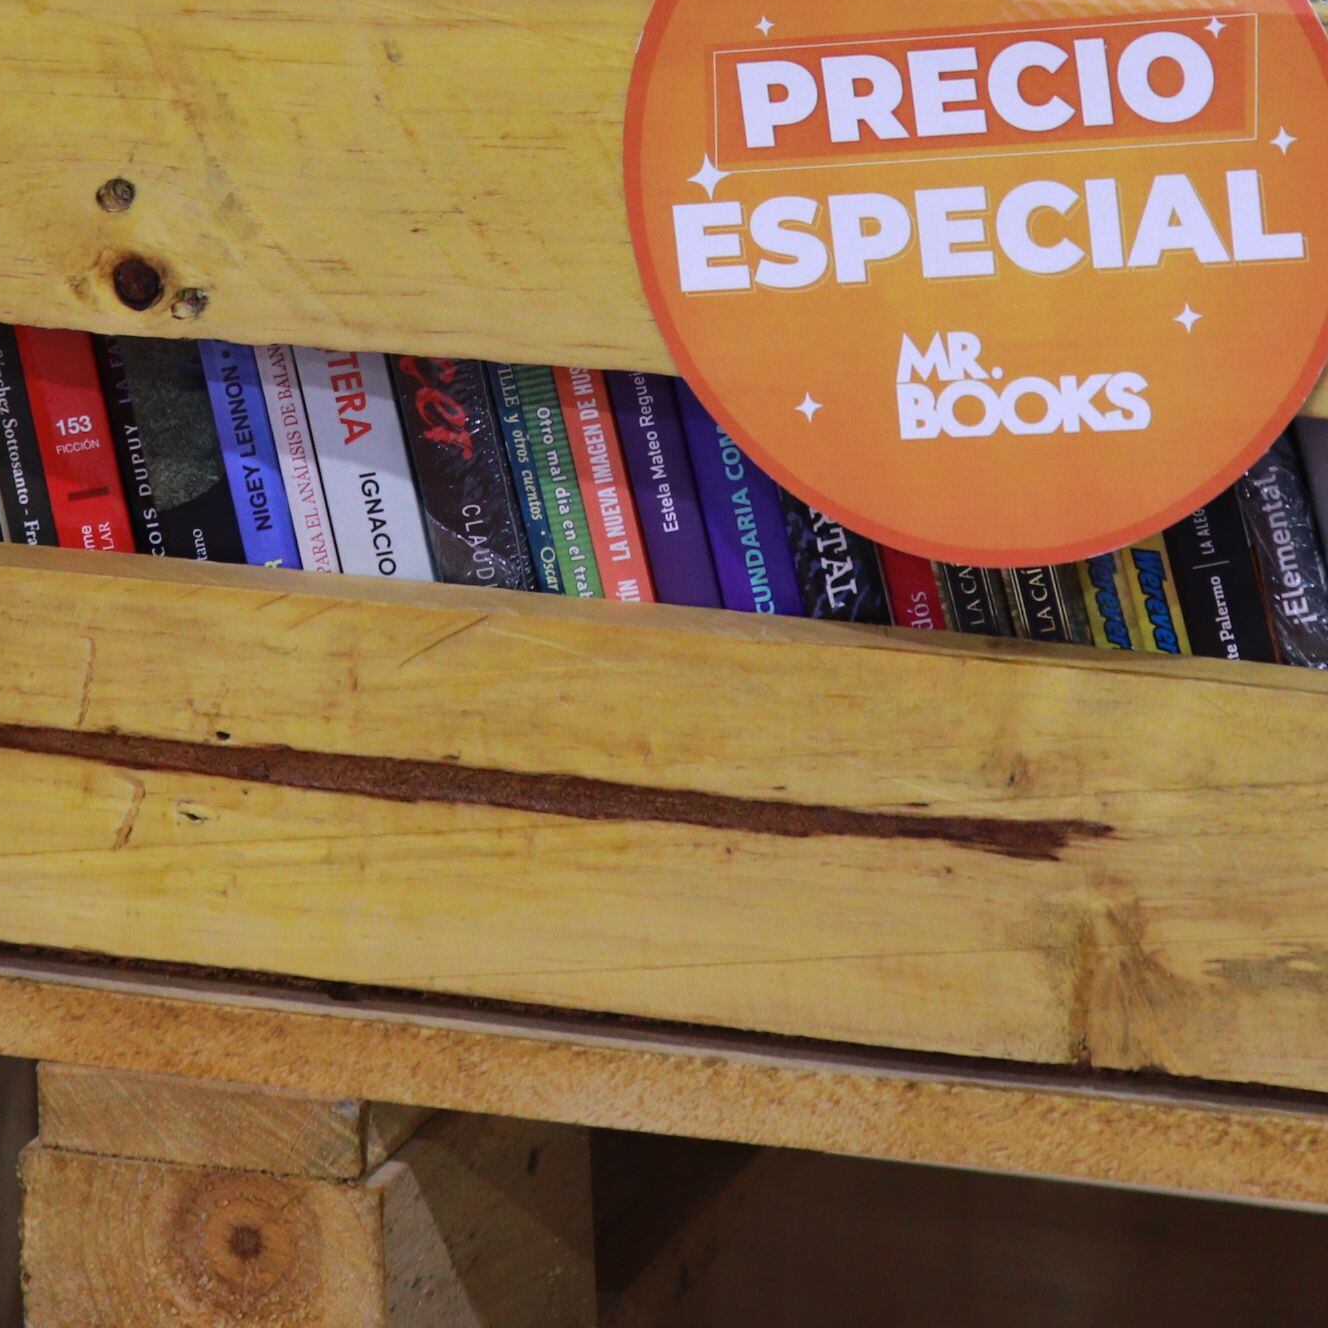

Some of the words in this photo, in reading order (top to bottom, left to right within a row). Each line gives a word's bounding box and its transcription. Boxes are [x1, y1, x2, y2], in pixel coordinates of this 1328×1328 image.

[736, 30, 1215, 148] PRECIO
[672, 169, 1306, 293] ESPECIAL
[267, 343, 293, 399] BALAN
[898, 330, 1004, 384] MR.
[220, 364, 258, 459] LENNON
[281, 403, 297, 426] DE
[324, 349, 374, 446] TERA
[576, 397, 600, 422] DE
[898, 372, 1152, 440] BOOKS
[55, 414, 93, 437] 153
[56, 437, 101, 456] FICCIÓN
[535, 407, 555, 446] Otro
[1, 417, 30, 506] Sottosanto
[123, 423, 154, 497] DUPUY
[286, 429, 317, 505] ANÁLISIS
[546, 450, 567, 482] mal
[582, 423, 614, 484] IMAGEN
[645, 429, 667, 480] Mateo
[241, 464, 273, 532] NIGEY
[307, 507, 322, 530] EL
[359, 471, 397, 576] IGNACIO
[511, 429, 529, 463] otros
[521, 469, 543, 521] cuentos
[540, 546, 559, 591] Oscar
[597, 485, 625, 539] NUEVA
[656, 482, 680, 533] Estela
[461, 503, 497, 589] CLAUD
[562, 520, 577, 541] en
[568, 545, 586, 562] el
[608, 539, 632, 563] LA
[1202, 535, 1215, 555] LA
[966, 599, 986, 626] LA
[1038, 606, 1055, 634] LA
[1210, 574, 1237, 643] Palermo
